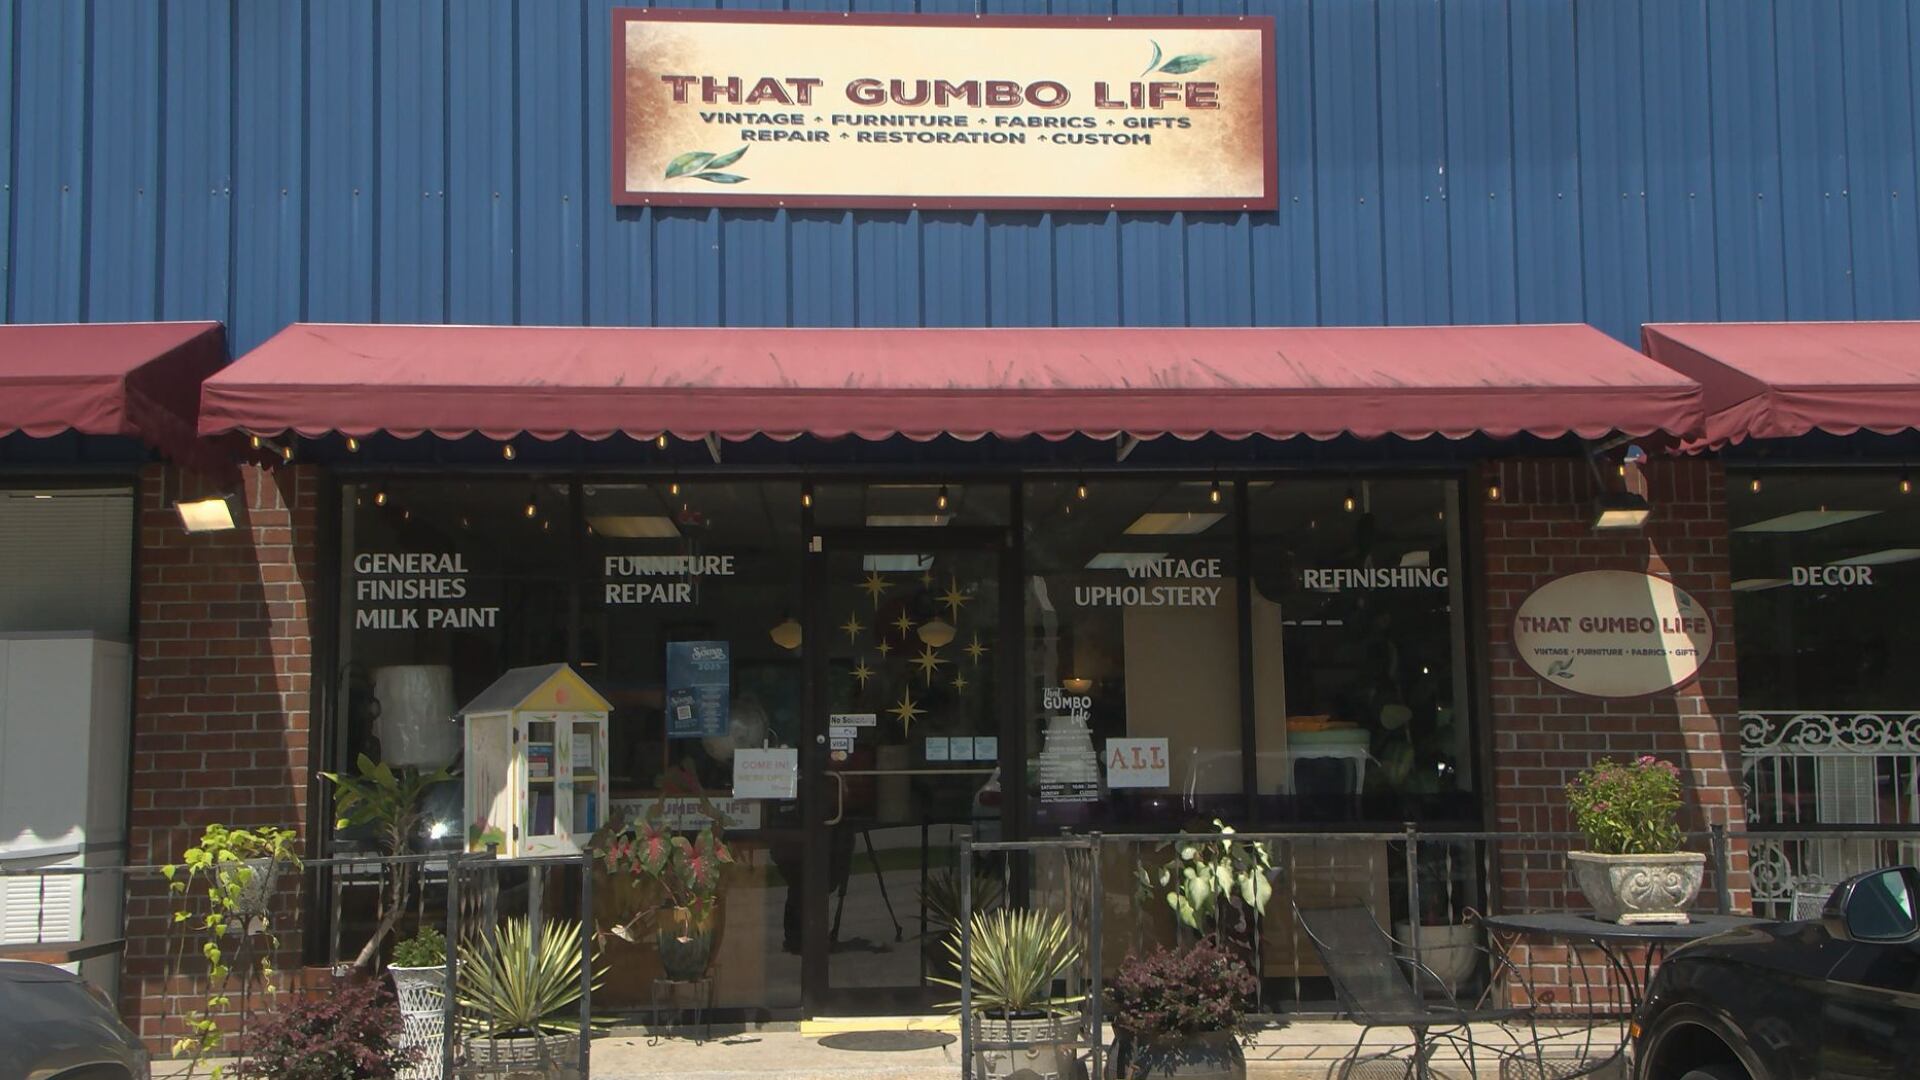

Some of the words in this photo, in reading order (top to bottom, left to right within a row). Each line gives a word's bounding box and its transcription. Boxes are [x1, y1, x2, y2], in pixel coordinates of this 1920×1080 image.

[661, 75, 823, 106] THAT
[846, 78, 1071, 109] GUMBO
[1094, 81, 1220, 110] LIFE
[699, 111, 805, 125] VINTAGE
[831, 113, 968, 127] FURNITURE
[995, 116, 1097, 128] FABRICS
[1123, 117, 1192, 129] GIFTS
[741, 129, 830, 142] REPAIR
[856, 131, 1026, 144] RESTORATION
[1051, 132, 1152, 145] CUSTOM
[354, 553, 468, 574] GENERAL
[605, 555, 735, 576] FURNITURE
[1125, 558, 1222, 578] VINTAGE
[1303, 568, 1449, 588] REFINISHING
[1791, 565, 1872, 586] DECOR
[357, 578, 467, 600] FINISHES
[605, 583, 692, 604] REPAIR
[1075, 586, 1221, 606] UPHOLSTERY
[355, 608, 420, 629] MILK
[427, 607, 500, 628] PAINT
[1519, 616, 1572, 634] THAT
[1579, 616, 1655, 634] GUMBO
[1662, 617, 1706, 634] LIFE
[1533, 648, 1569, 656] VINTAGE
[1576, 648, 1623, 657] FURNITURE
[1631, 648, 1667, 657] FABRICS
[1675, 649, 1700, 657] GIFTS
[1043, 696, 1092, 709] GUMBO
[831, 716, 841, 724] No
[742, 760, 774, 769] COME
[1109, 745, 1165, 769] ALL
